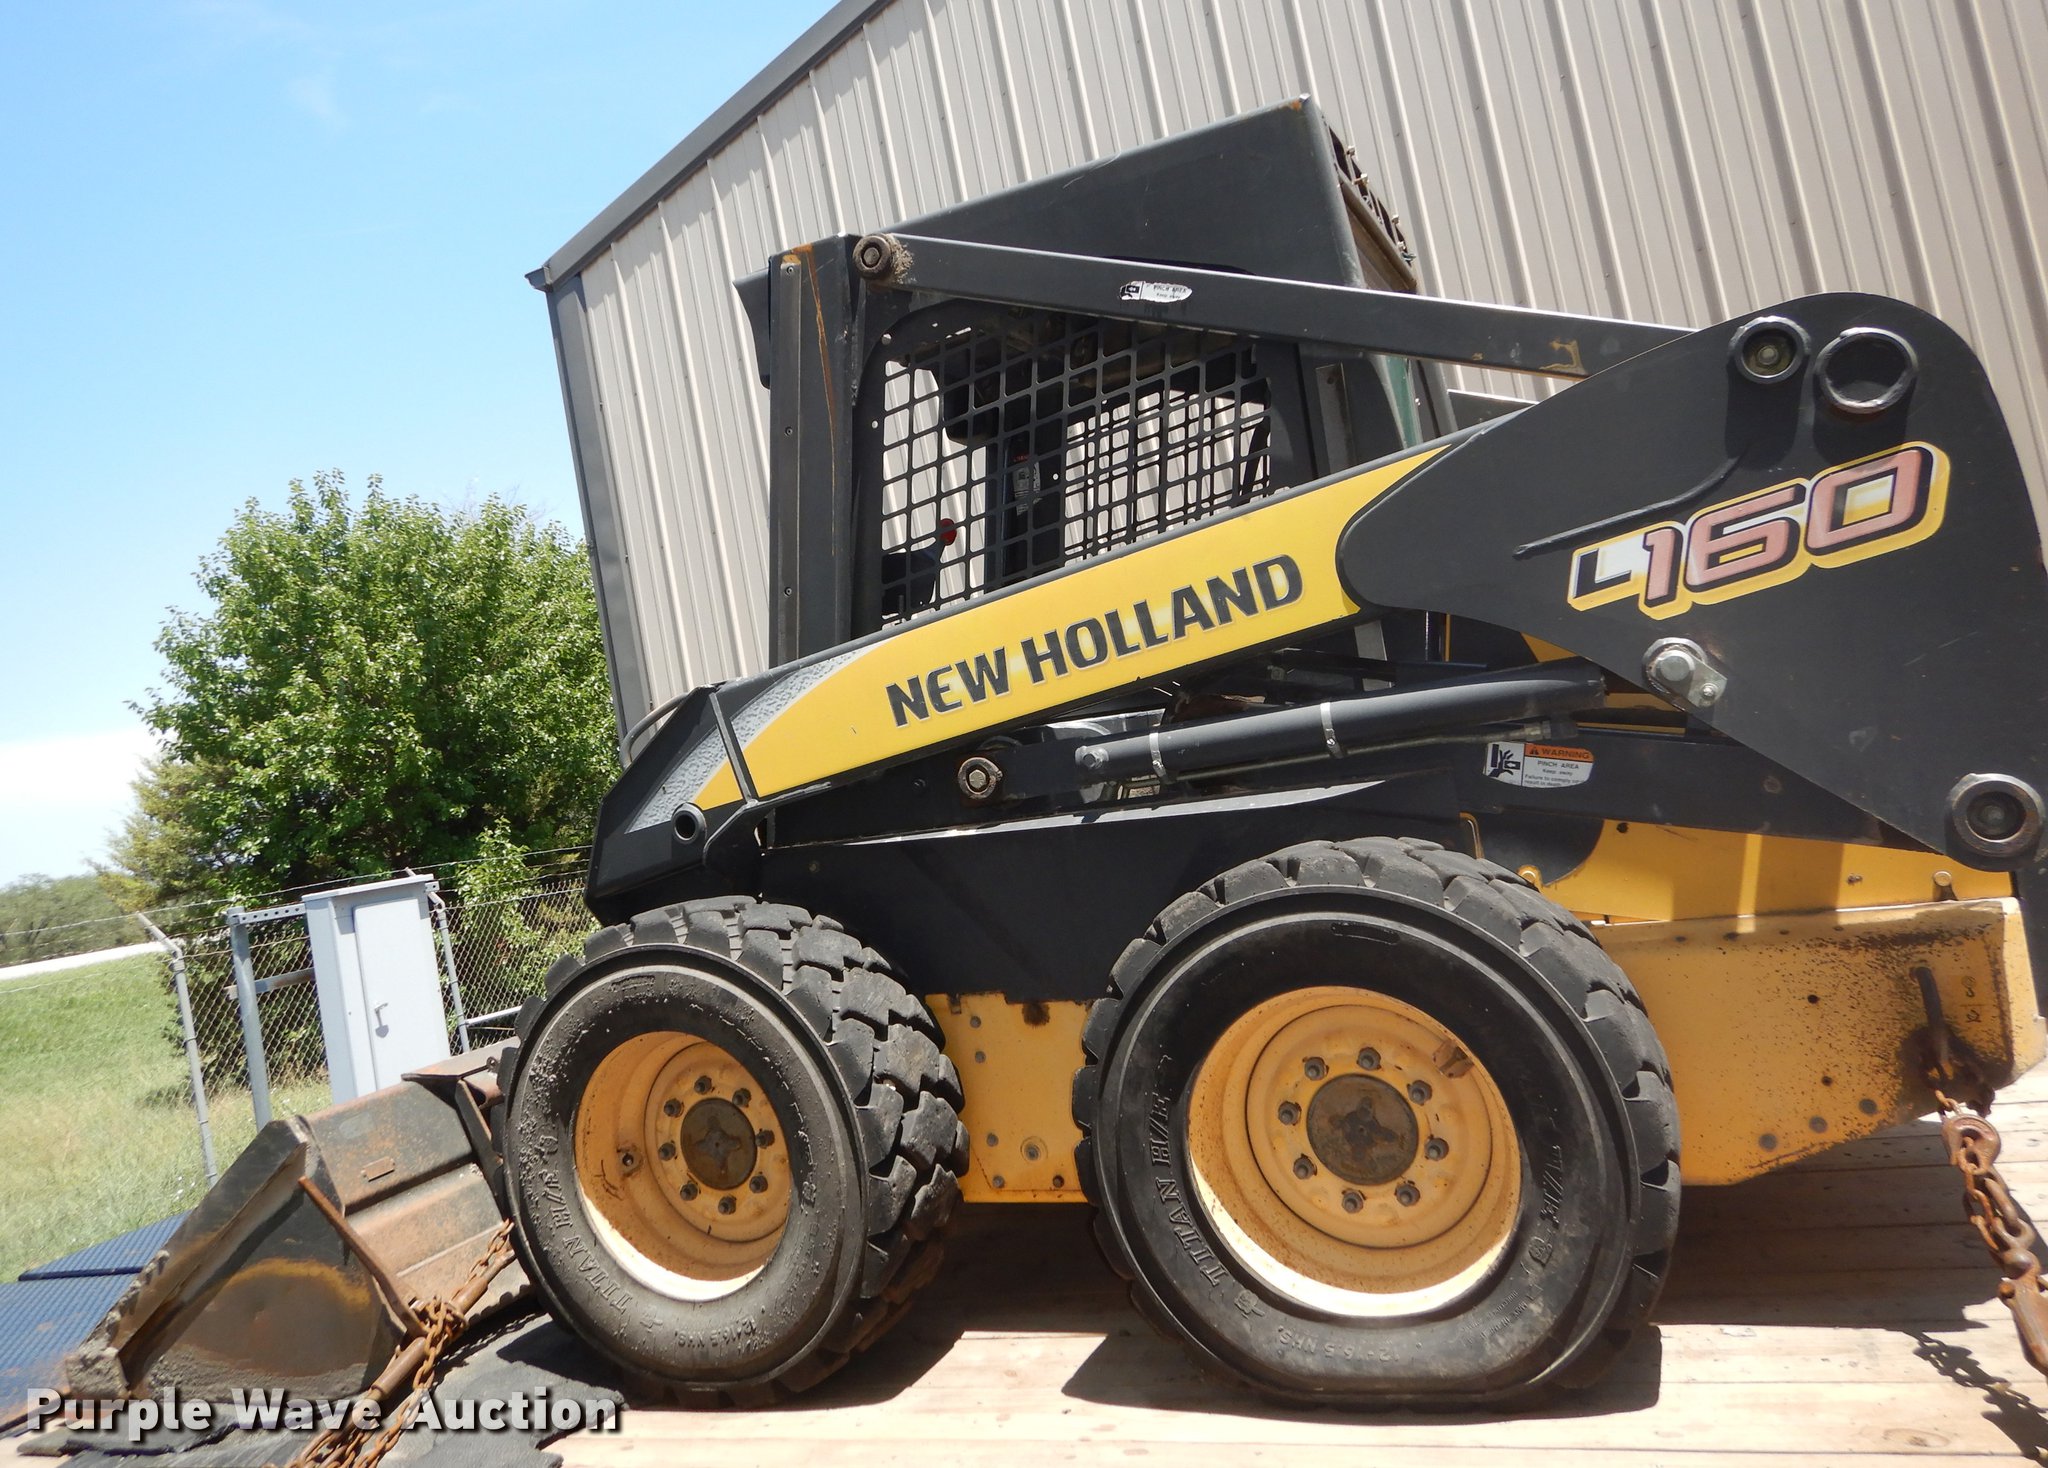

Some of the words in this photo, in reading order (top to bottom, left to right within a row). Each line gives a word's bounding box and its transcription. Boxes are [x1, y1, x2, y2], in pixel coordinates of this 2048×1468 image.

[1570, 443, 1945, 615] L160
[885, 645, 1010, 728] NEW
[1020, 554, 1303, 684] HOLLAND
[1537, 760, 1558, 768] PINCH
[1542, 748, 1590, 759] WARNING
[562, 1235, 633, 1313] TITAN
[1155, 1176, 1230, 1286] TITAN
